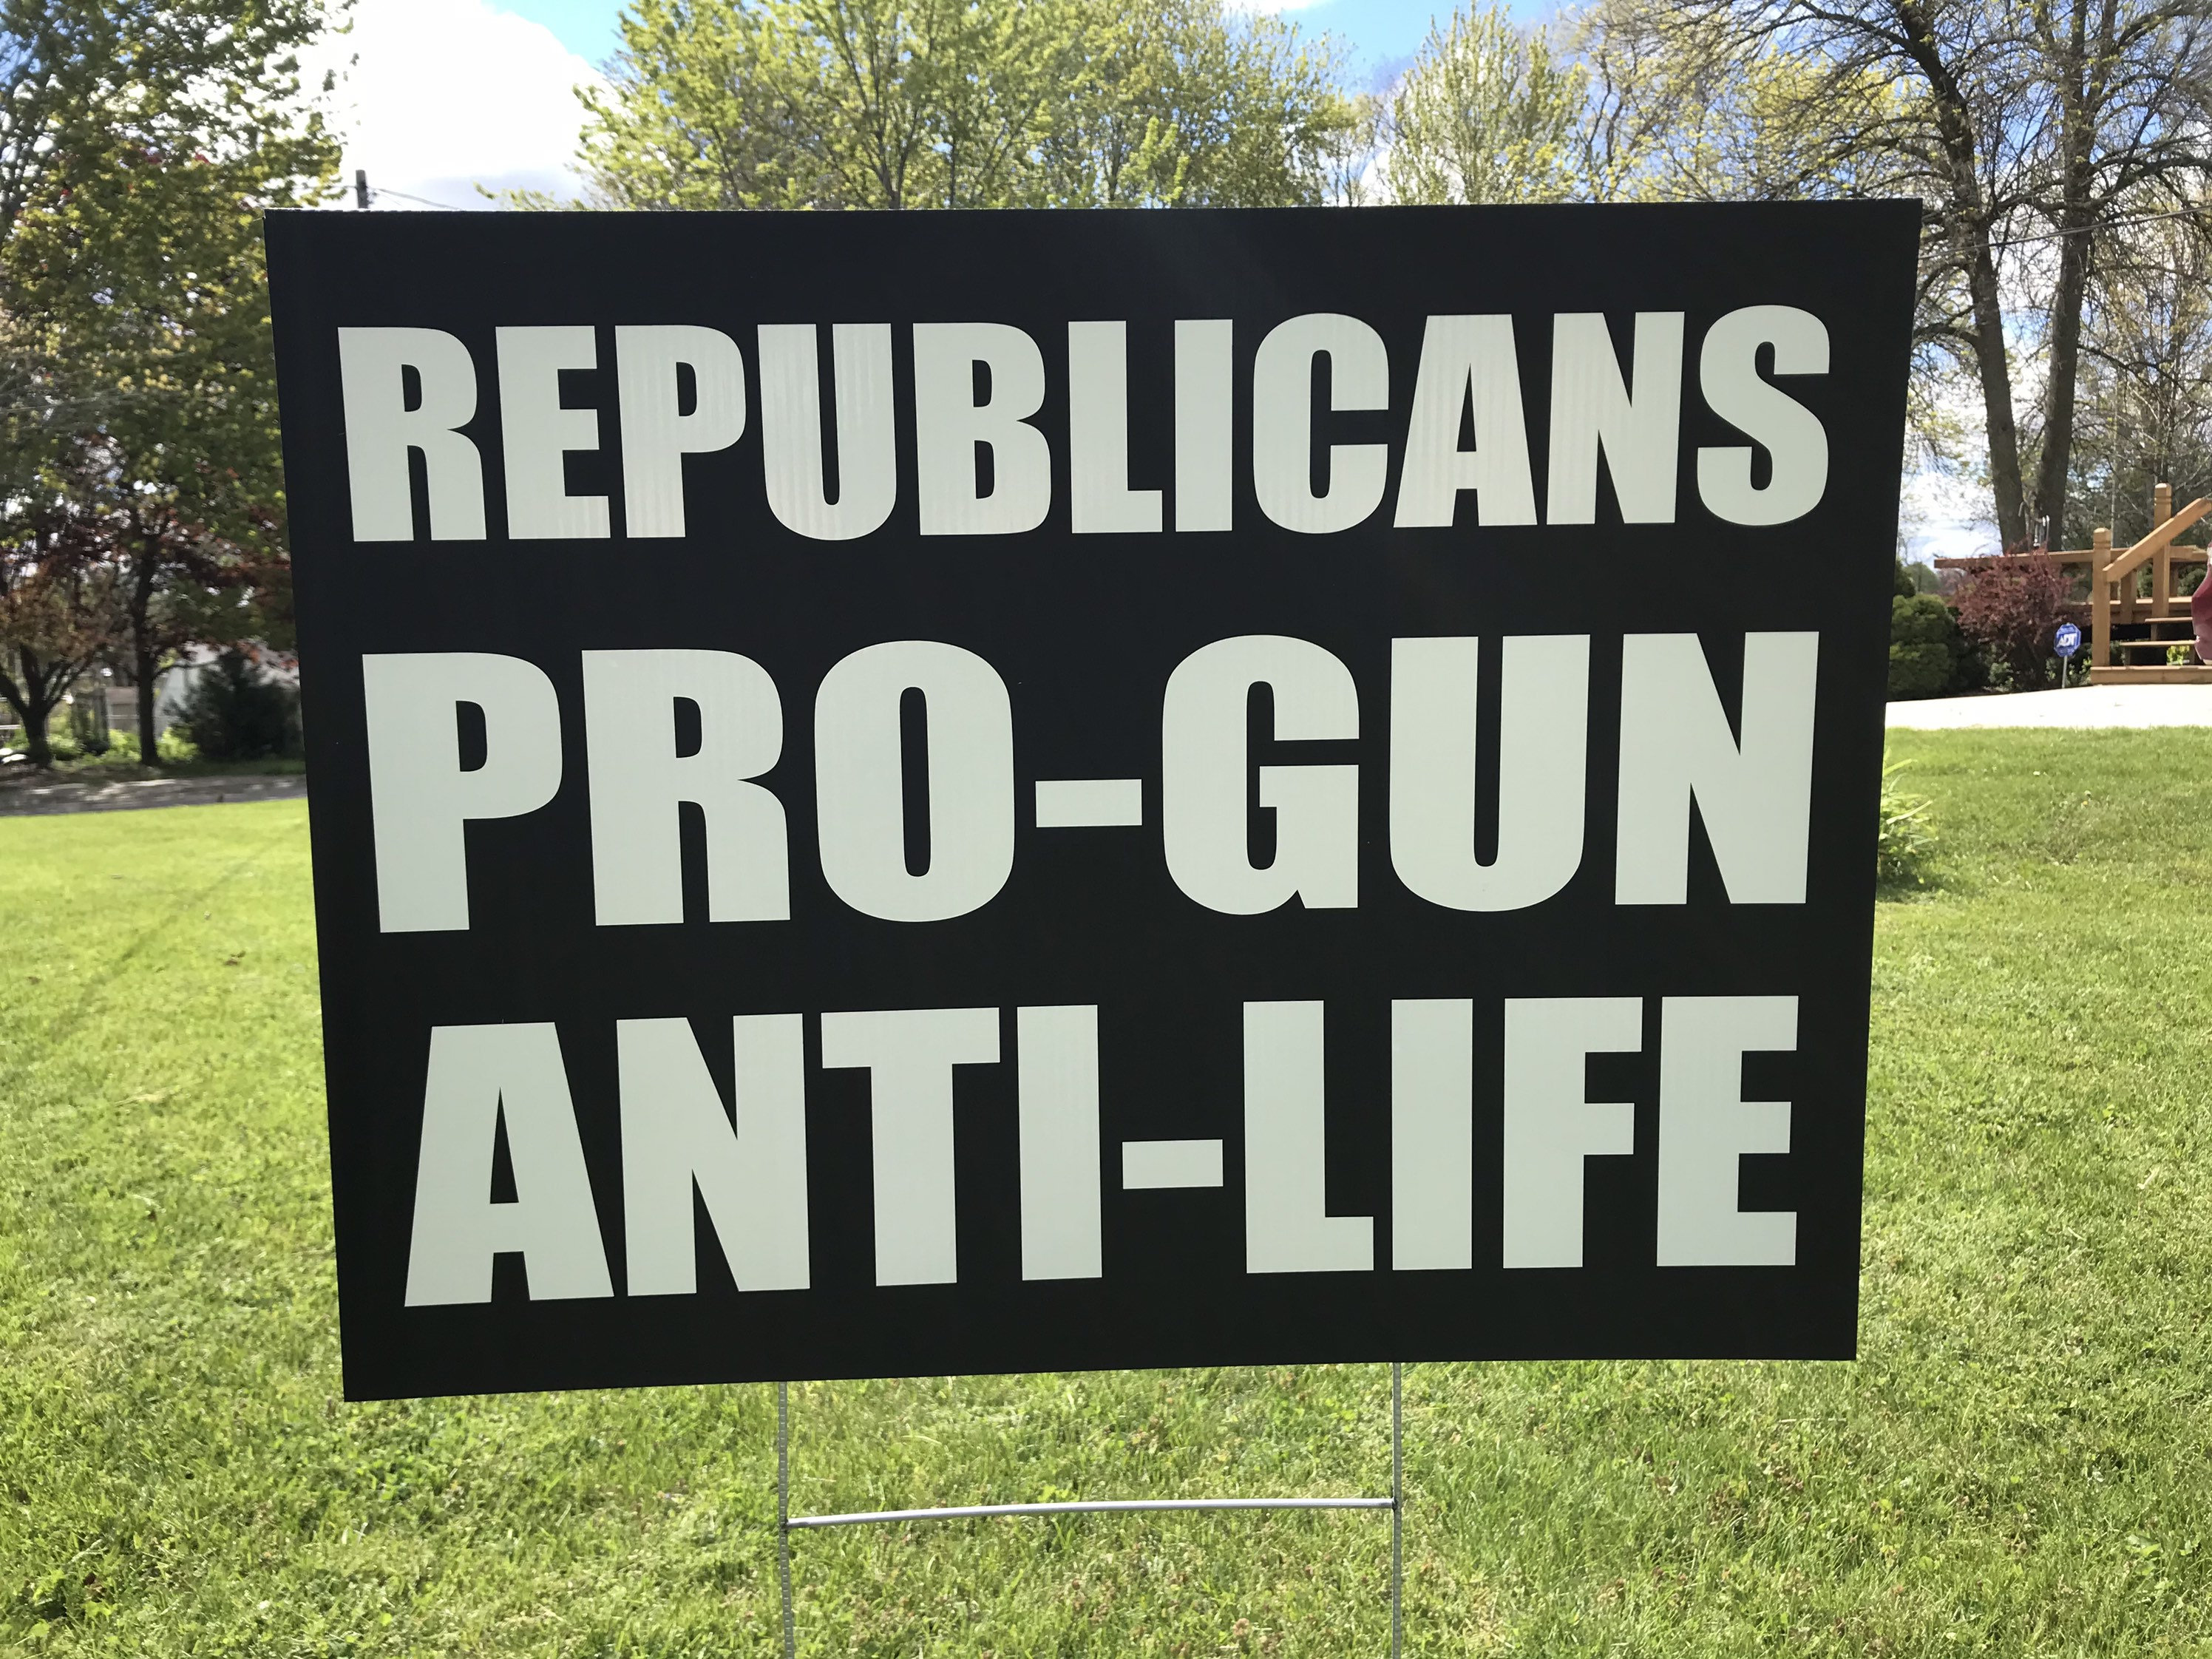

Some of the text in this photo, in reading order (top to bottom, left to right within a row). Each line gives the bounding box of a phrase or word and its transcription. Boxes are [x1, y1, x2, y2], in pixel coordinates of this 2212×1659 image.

[338, 305, 1830, 542] REPUBLICANS
[2057, 633, 2077, 648] ADT
[362, 631, 1819, 933] PRO-GUN
[404, 995, 1799, 1307] ANTI-LIFE
